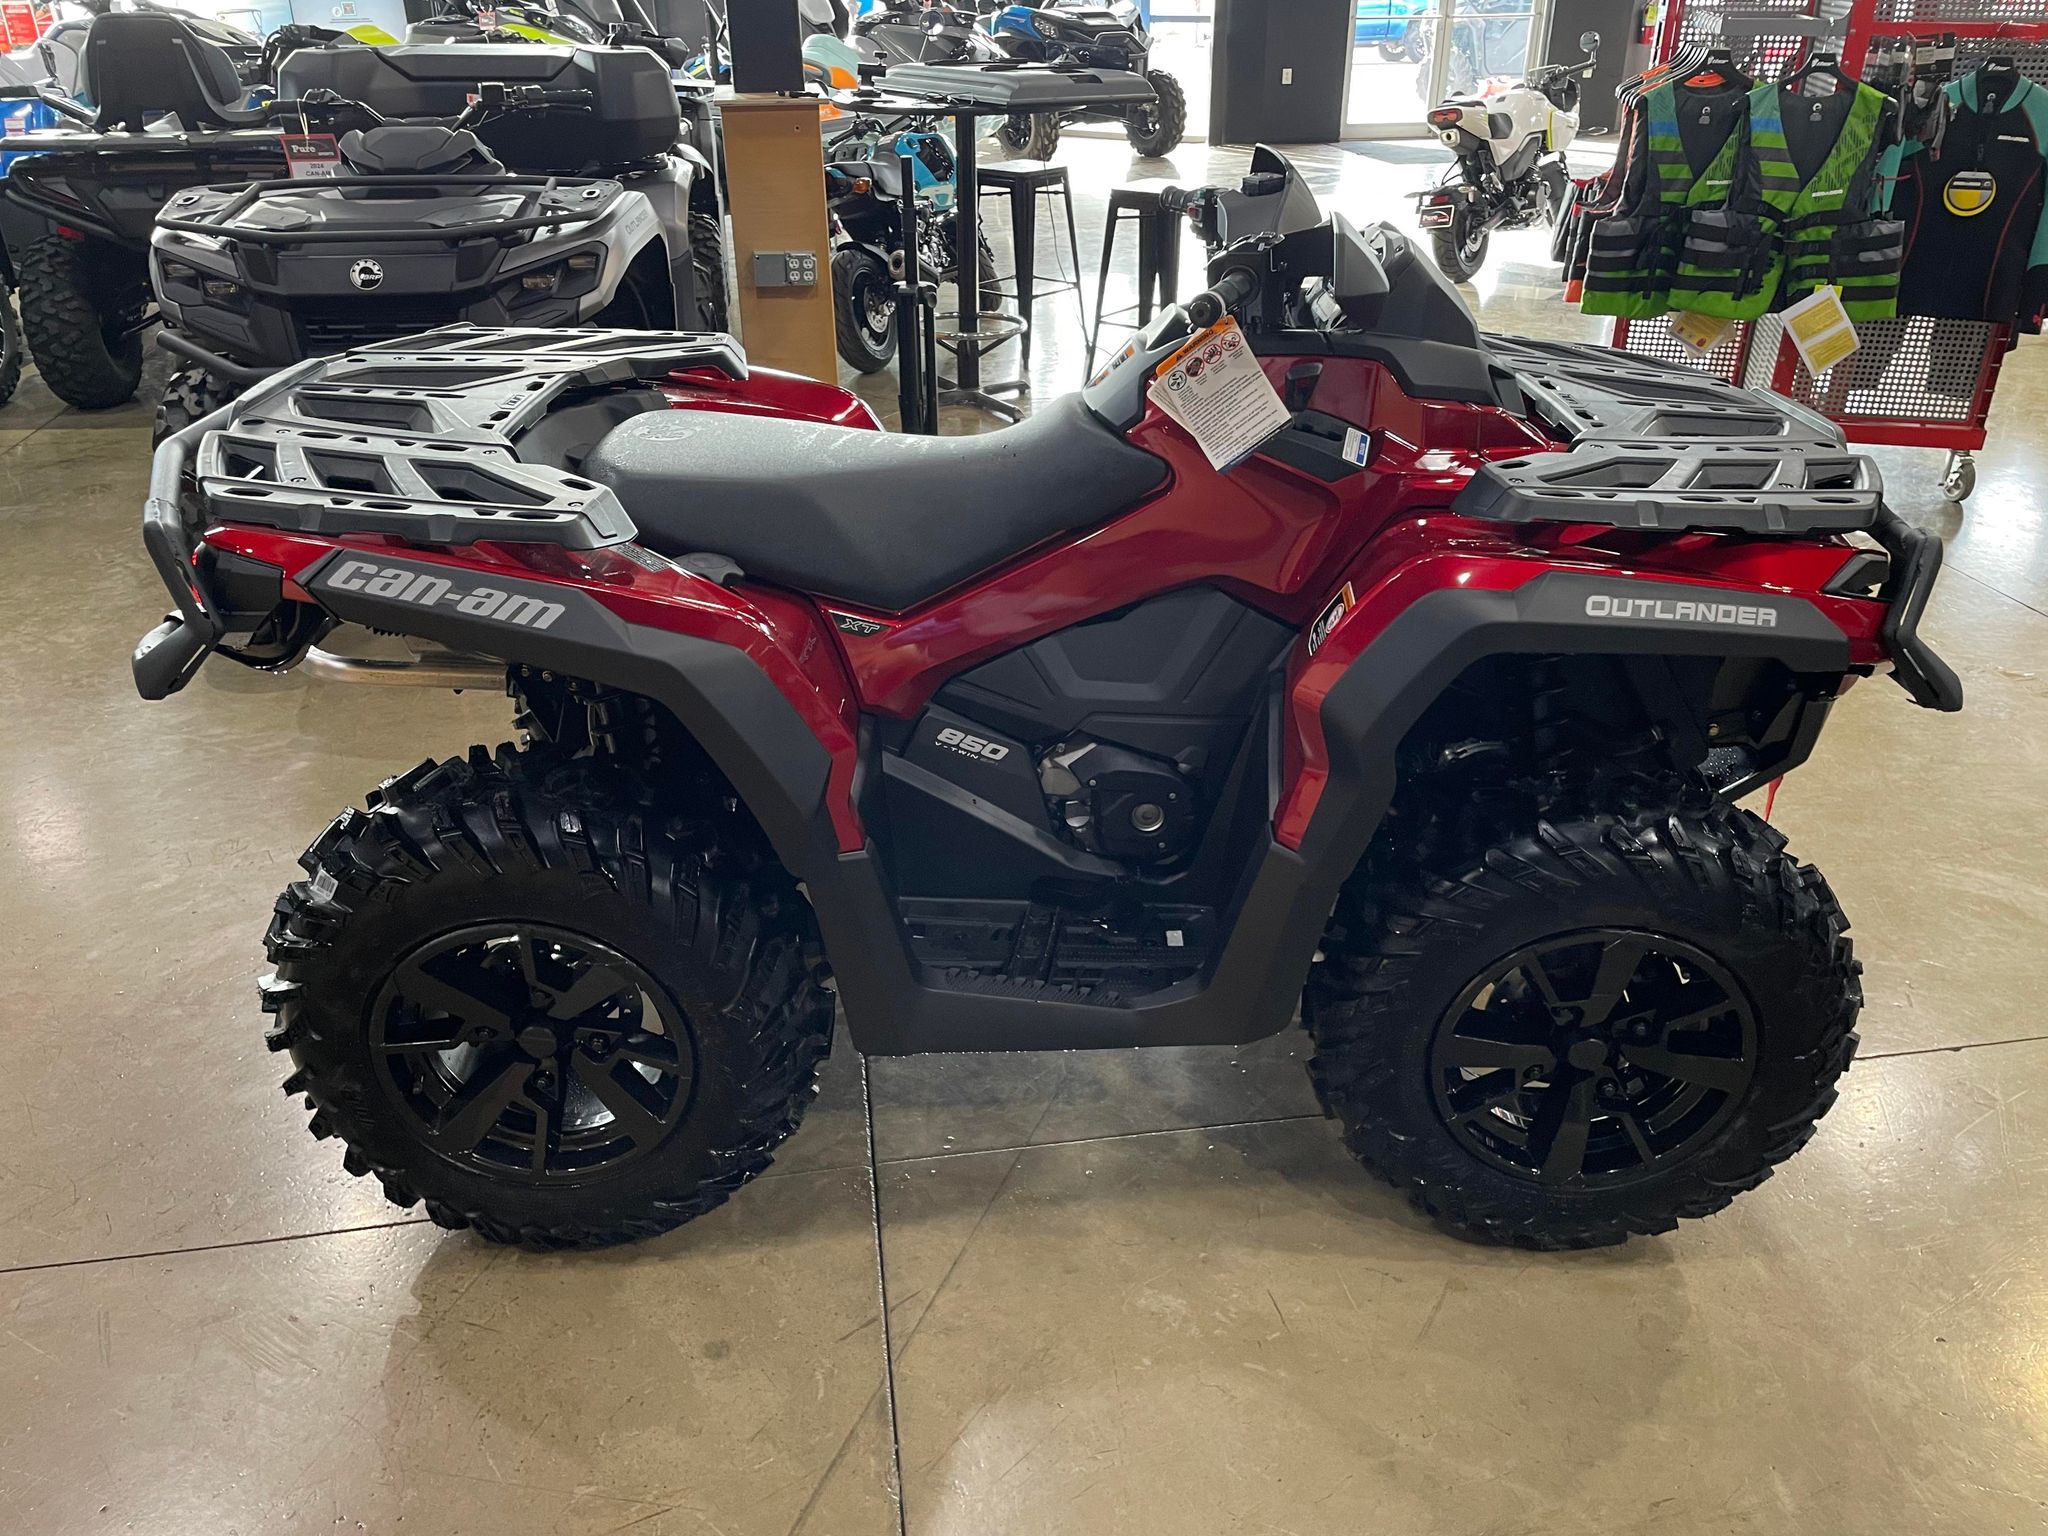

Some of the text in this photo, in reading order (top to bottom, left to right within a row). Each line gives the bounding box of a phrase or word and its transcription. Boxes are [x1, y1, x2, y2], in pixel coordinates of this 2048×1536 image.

[291, 144, 316, 153] Pure
[326, 560, 566, 630] can-am
[1585, 594, 1778, 627] OUTLANDER
[840, 618, 881, 633] XT
[936, 727, 1010, 761] 850
